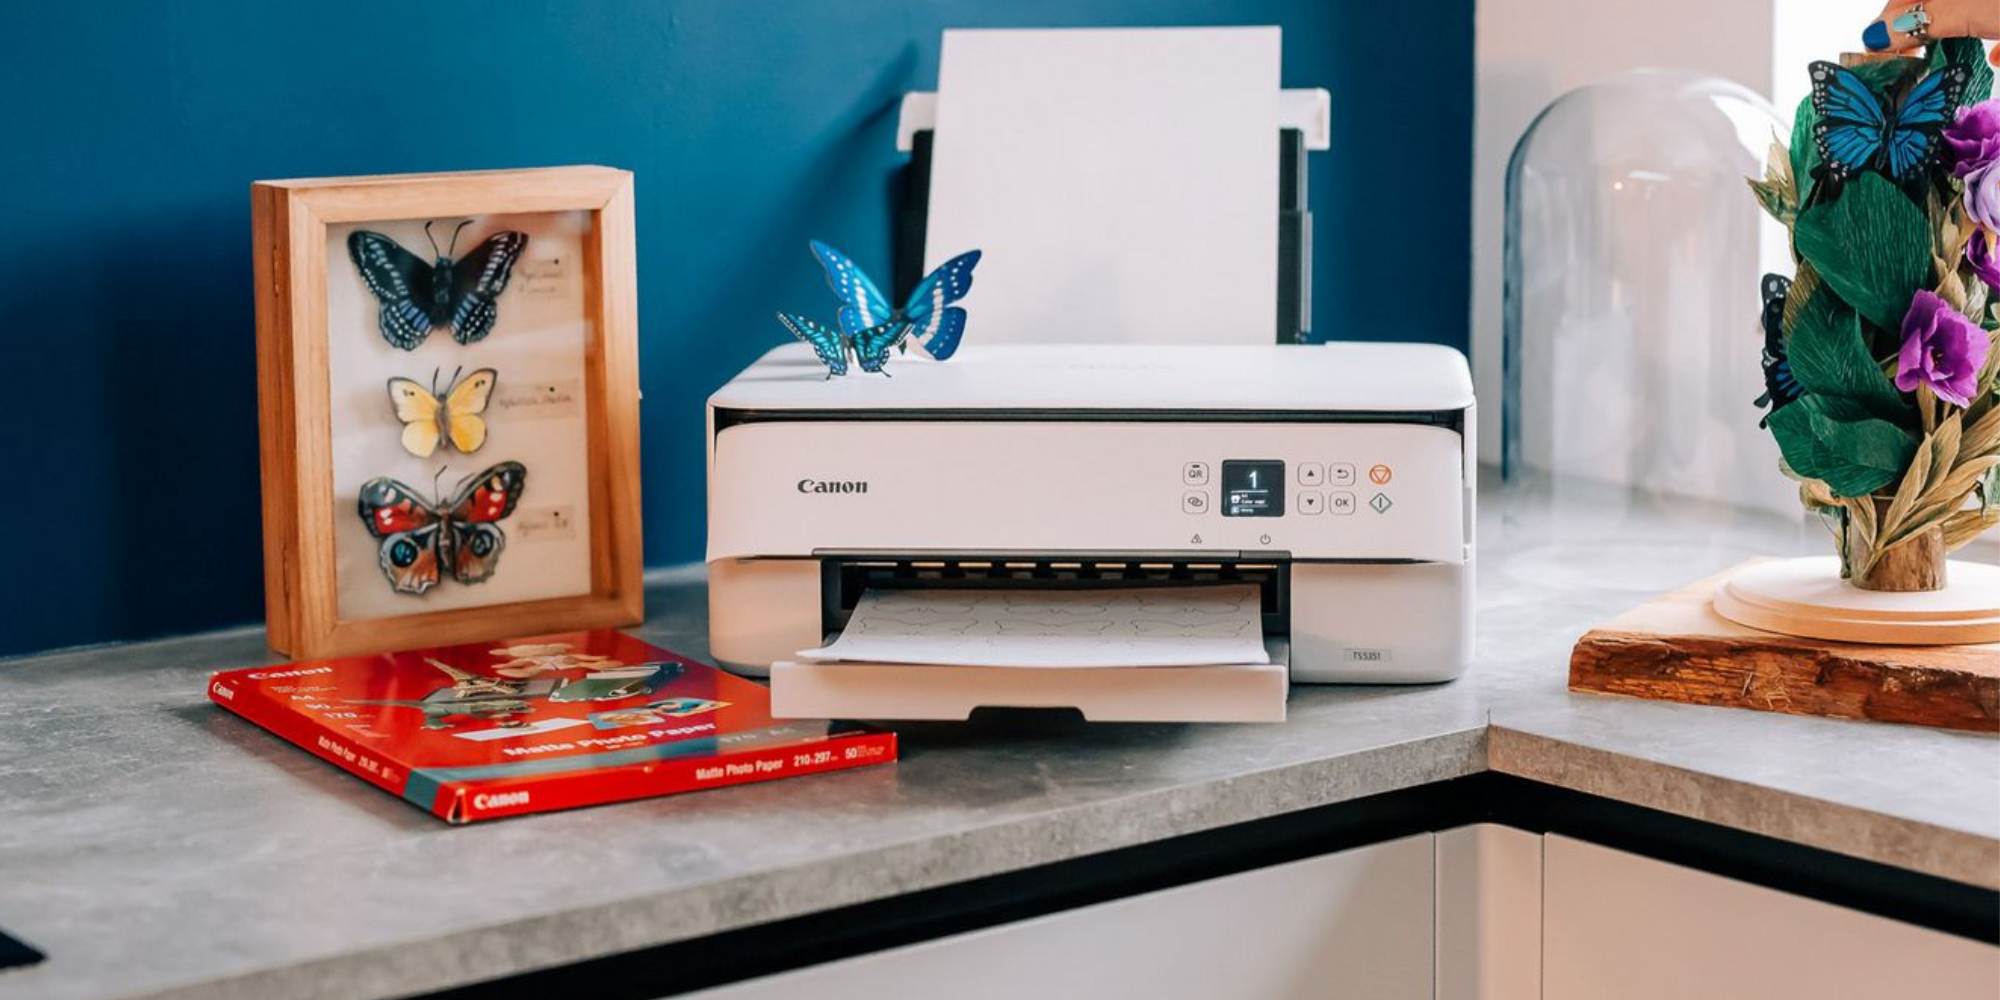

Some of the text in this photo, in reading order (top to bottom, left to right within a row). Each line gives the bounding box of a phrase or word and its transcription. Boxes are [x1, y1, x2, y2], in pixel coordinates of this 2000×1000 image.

[1188, 469, 1203, 479] QR
[1249, 470, 1257, 489] 1
[797, 478, 868, 494] Canon
[1335, 496, 1350, 508] OK
[247, 667, 333, 680] Canon
[213, 682, 234, 700] Canon
[503, 742, 575, 756] Matte
[576, 733, 647, 748] Photo
[649, 722, 716, 738] Paper
[696, 766, 724, 781] Matte
[725, 762, 754, 776] Photo
[755, 758, 783, 772] Paper
[474, 790, 530, 810] Canon
